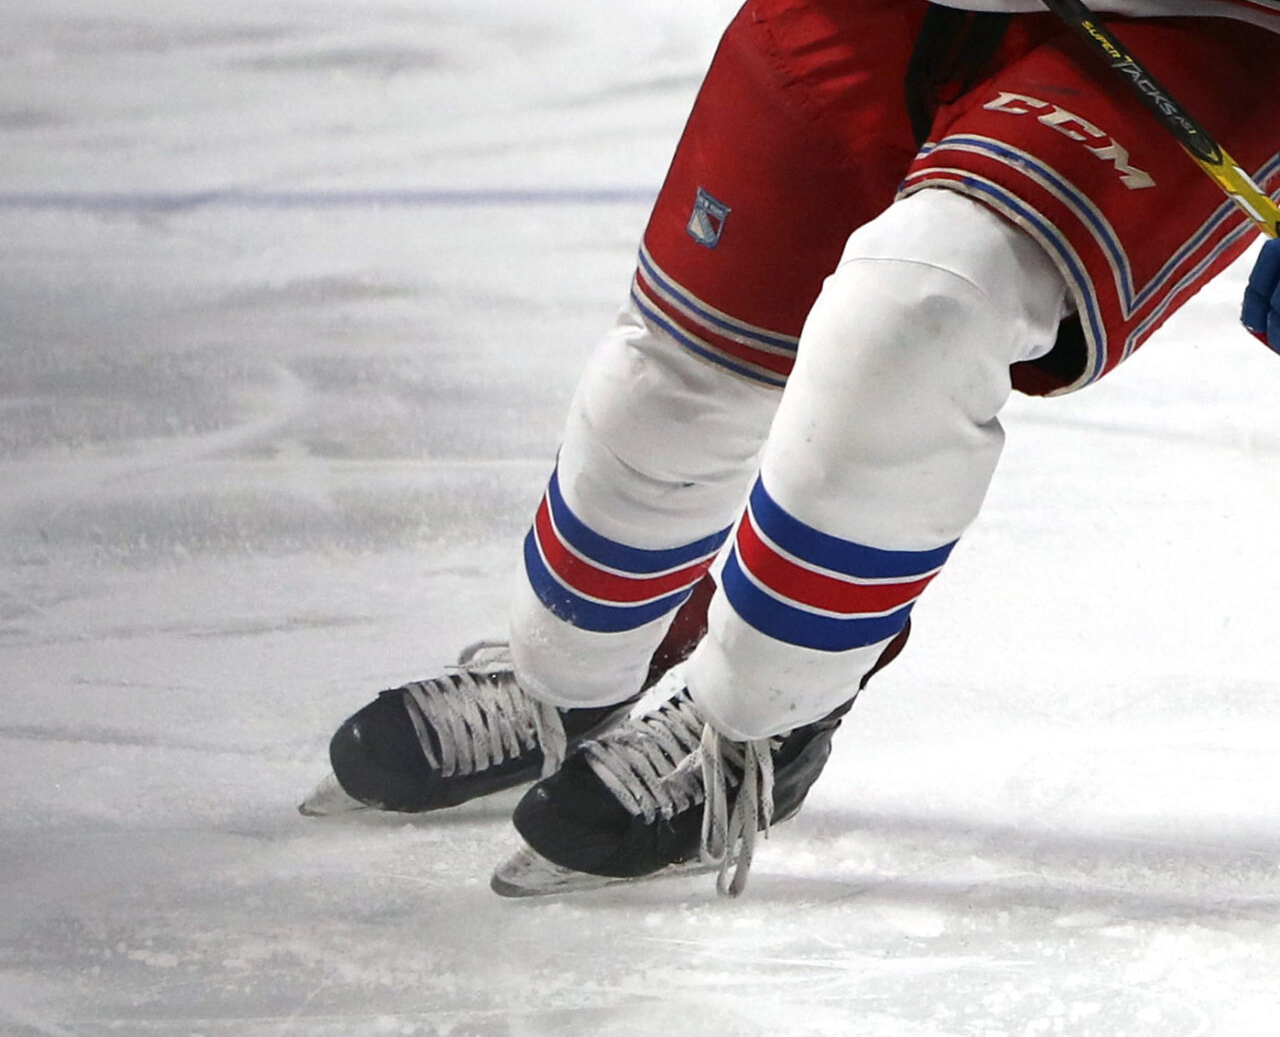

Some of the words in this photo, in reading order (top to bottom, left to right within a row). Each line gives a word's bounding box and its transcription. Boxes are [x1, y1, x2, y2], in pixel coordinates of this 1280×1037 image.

[1081, 20, 1122, 59] SUPER
[1111, 54, 1179, 116] TACKS
[982, 91, 1157, 190] CCM
